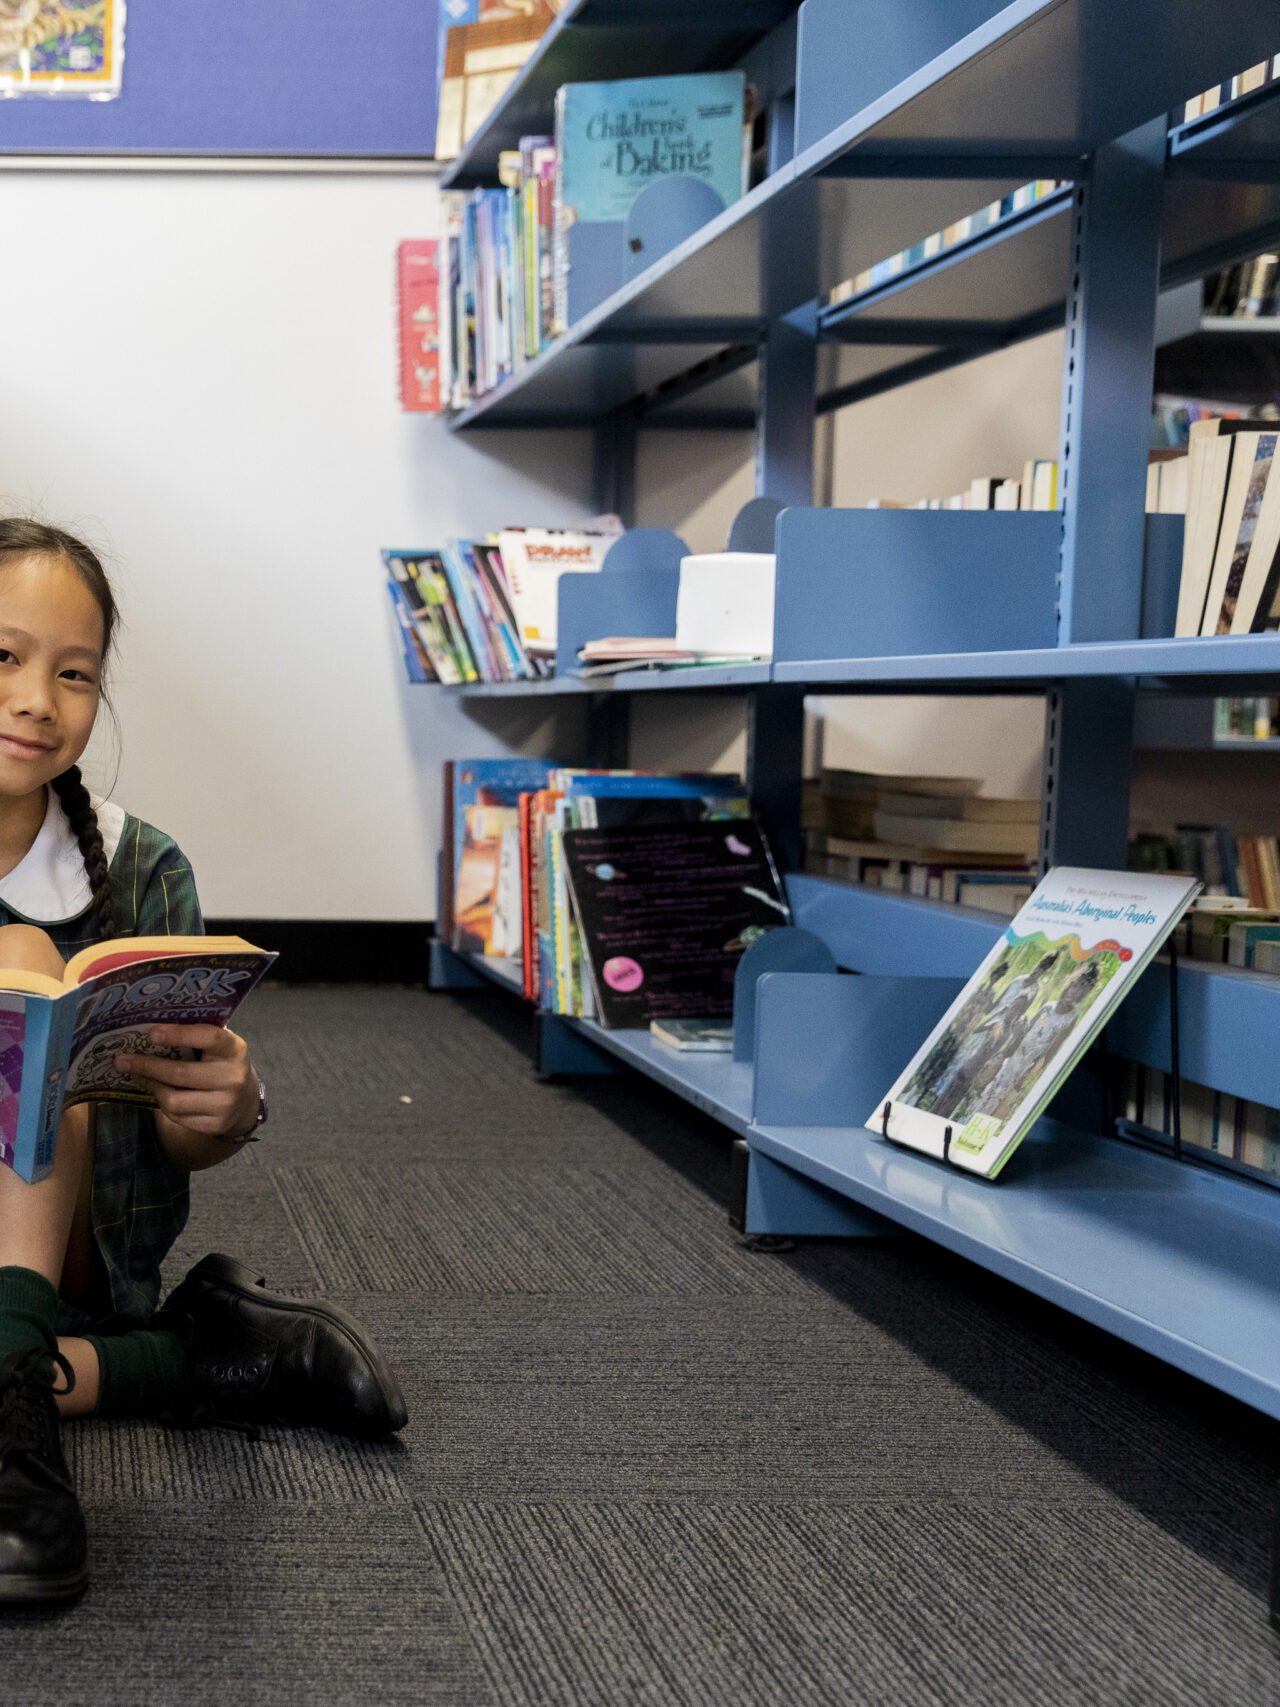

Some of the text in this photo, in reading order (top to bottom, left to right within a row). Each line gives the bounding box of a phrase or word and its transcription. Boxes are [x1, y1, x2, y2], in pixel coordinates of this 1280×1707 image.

[586, 111, 688, 141] Children's
[616, 138, 713, 177] Baking
[1072, 898, 1125, 922] Aboriginal
[1122, 903, 1158, 926] Peoples
[75, 967, 252, 1033] DORK
